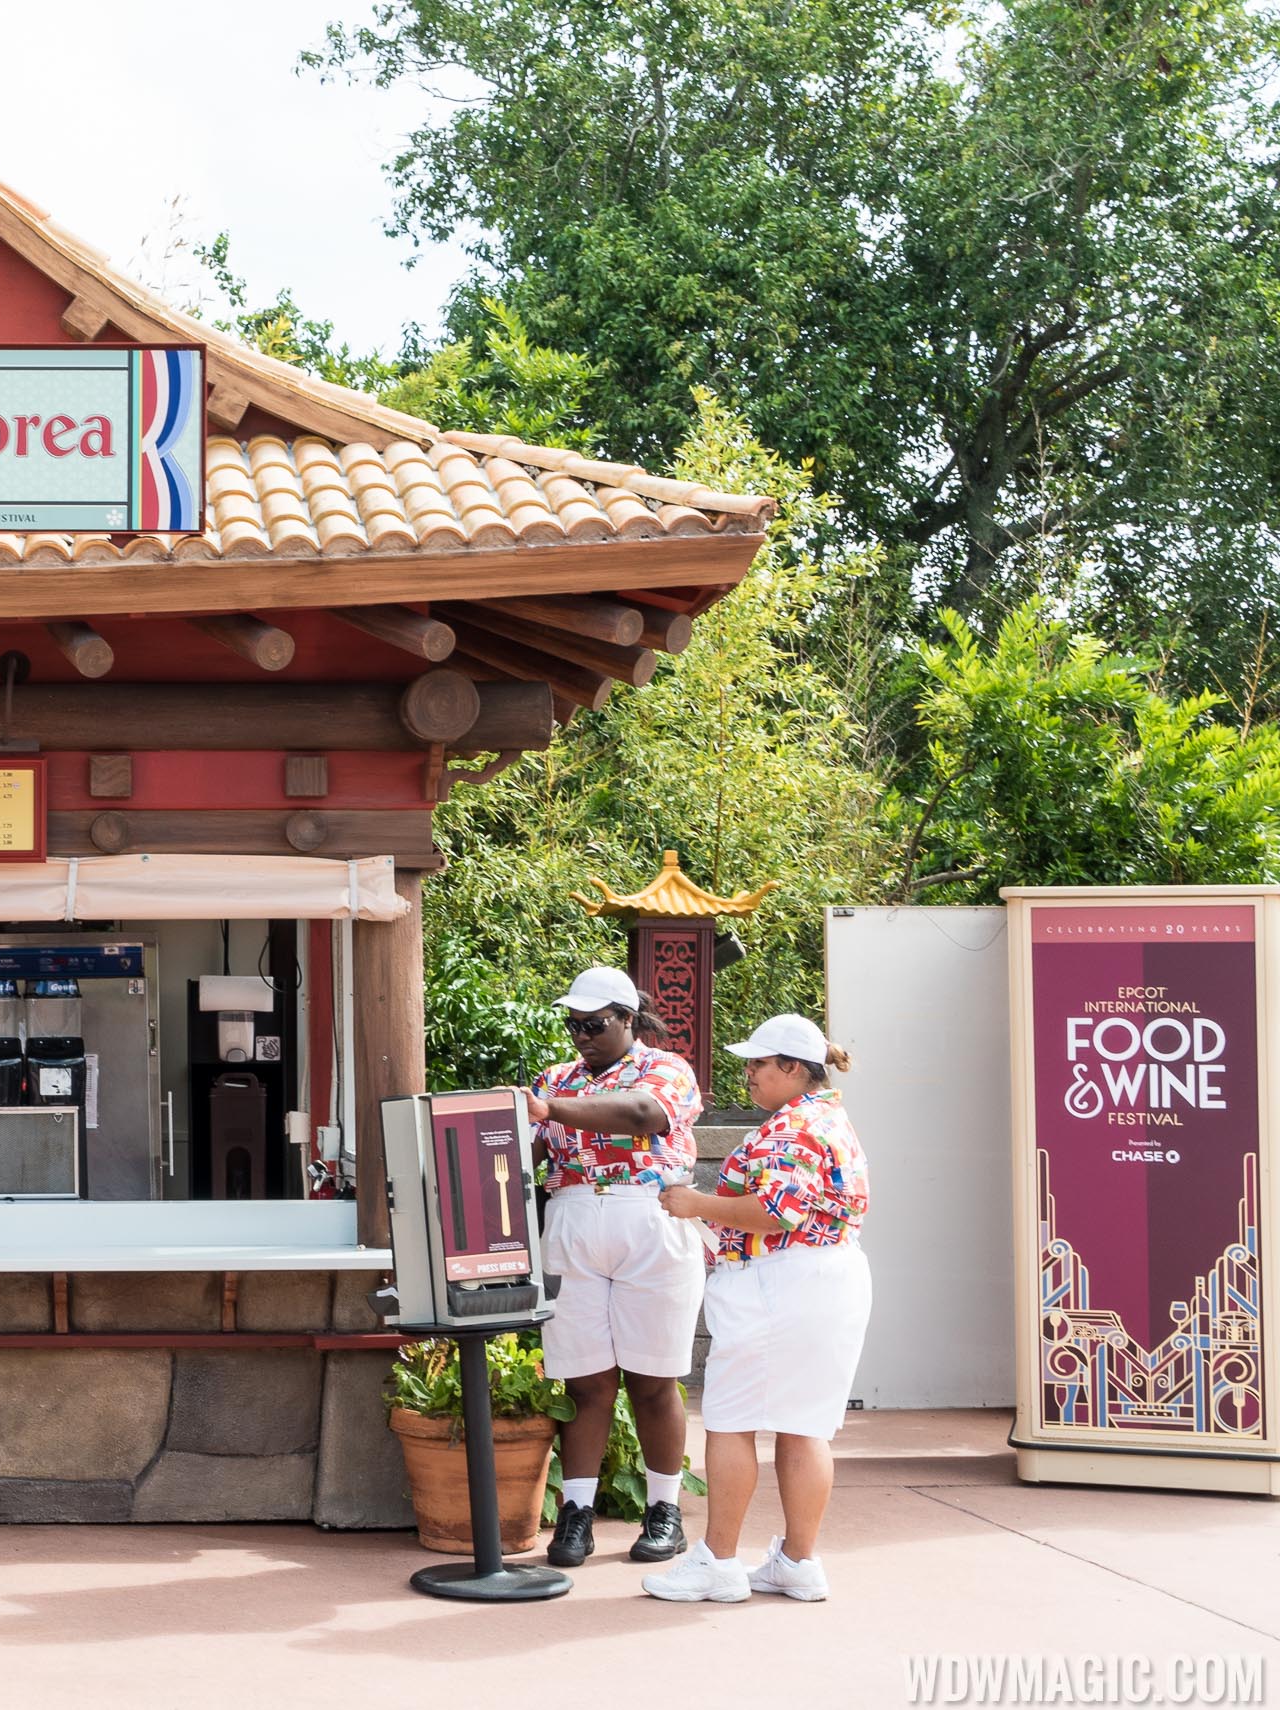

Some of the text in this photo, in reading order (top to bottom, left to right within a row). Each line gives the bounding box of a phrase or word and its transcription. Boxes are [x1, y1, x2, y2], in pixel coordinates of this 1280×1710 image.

[1046, 924, 1241, 935] CELEBRATING 20 YEARS
[1118, 986, 1167, 999] EPCOT
[1084, 1001, 1200, 1014] INTERNATIONAL
[1066, 1017, 1226, 1062] FOOD
[1064, 1063, 1227, 1119] & WINE
[1108, 1112, 1183, 1126] FESTIVAL
[1111, 1150, 1164, 1162] CHASE
[477, 1263, 500, 1275] PRESS
[500, 1261, 519, 1272] HERE
